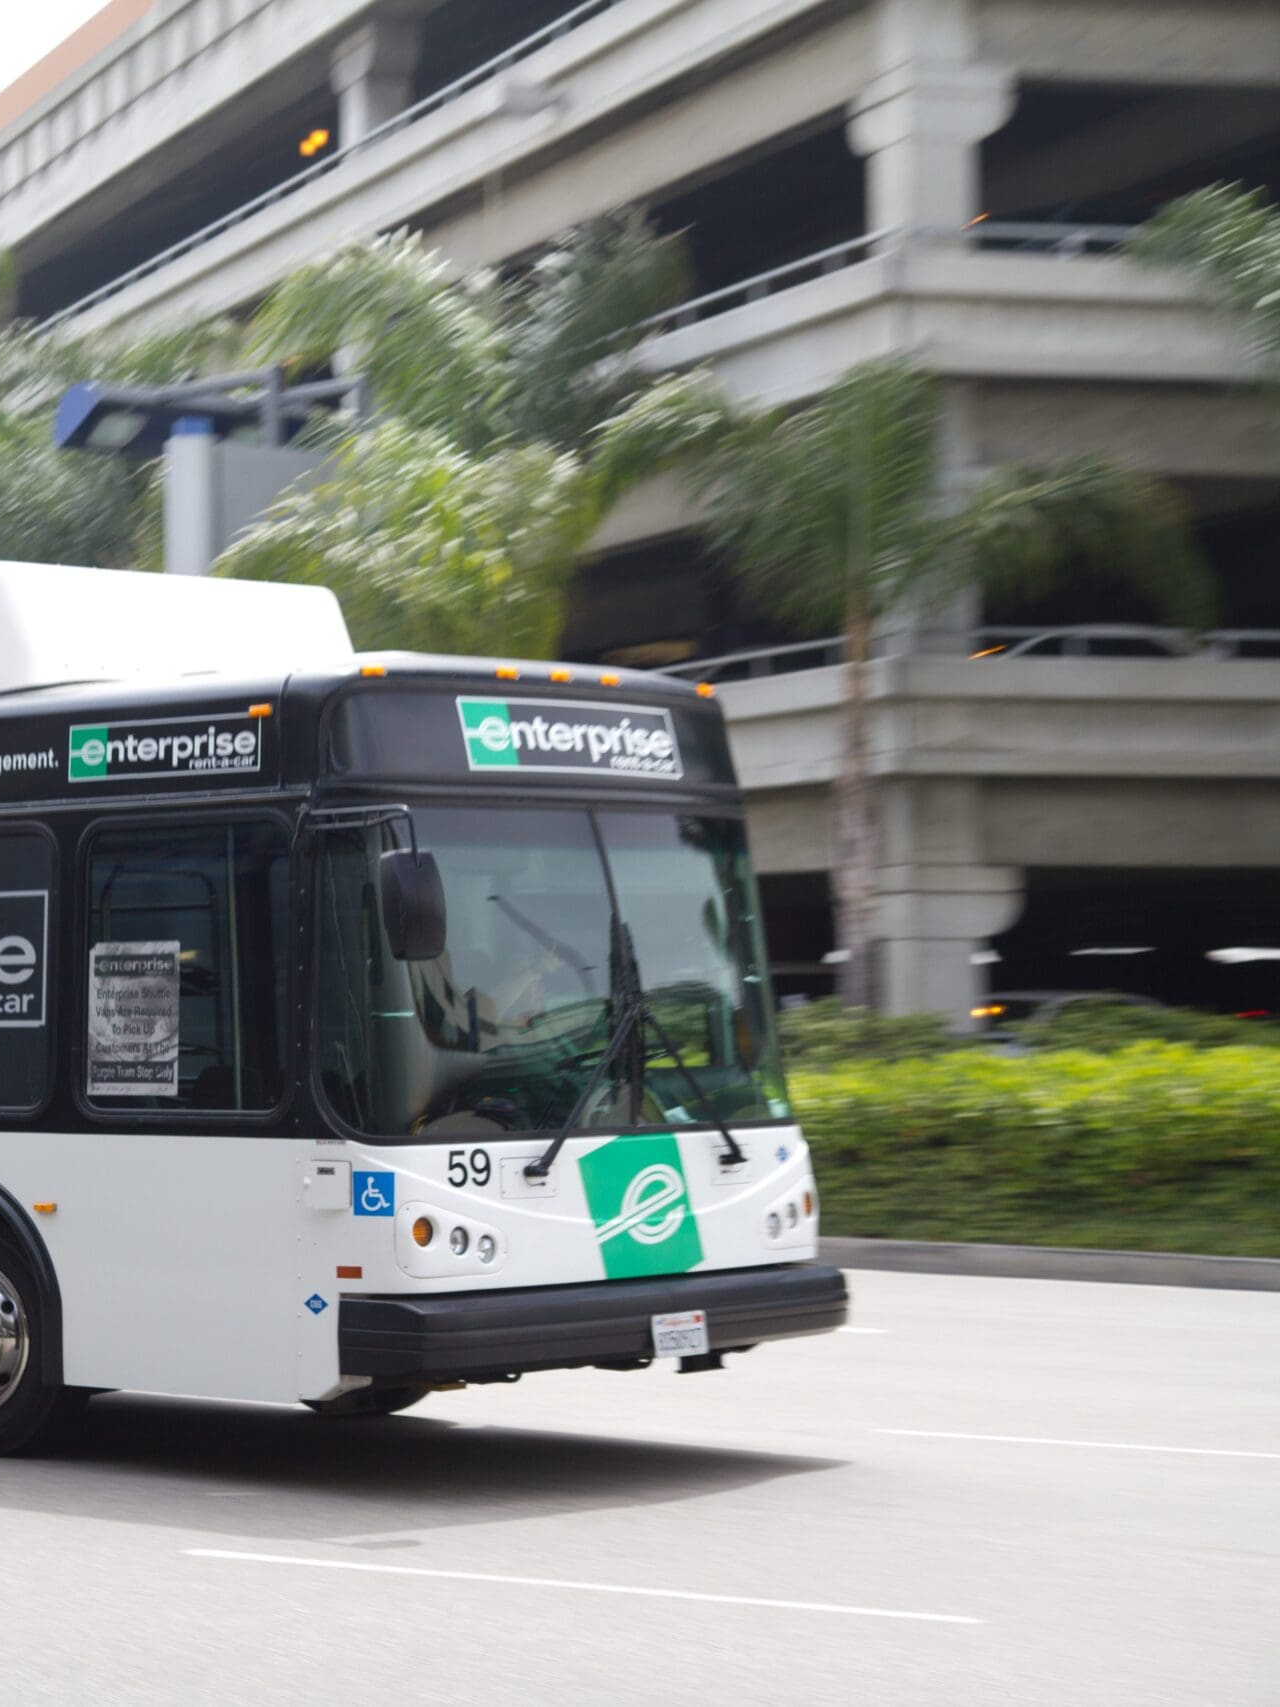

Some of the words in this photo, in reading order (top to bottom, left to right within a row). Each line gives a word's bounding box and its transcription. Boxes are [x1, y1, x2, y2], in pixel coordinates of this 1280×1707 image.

[81, 725, 257, 767] enterprise
[478, 715, 674, 763] enterprise
[189, 754, 256, 770] rent-a-car
[98, 956, 174, 973] enterprise
[96, 987, 139, 1002] Enterprise
[134, 1006, 173, 1018] Required
[111, 1024, 122, 1035] To
[124, 1023, 141, 1035] Pick
[143, 1024, 155, 1037] Up
[447, 1148, 491, 1188] 59
